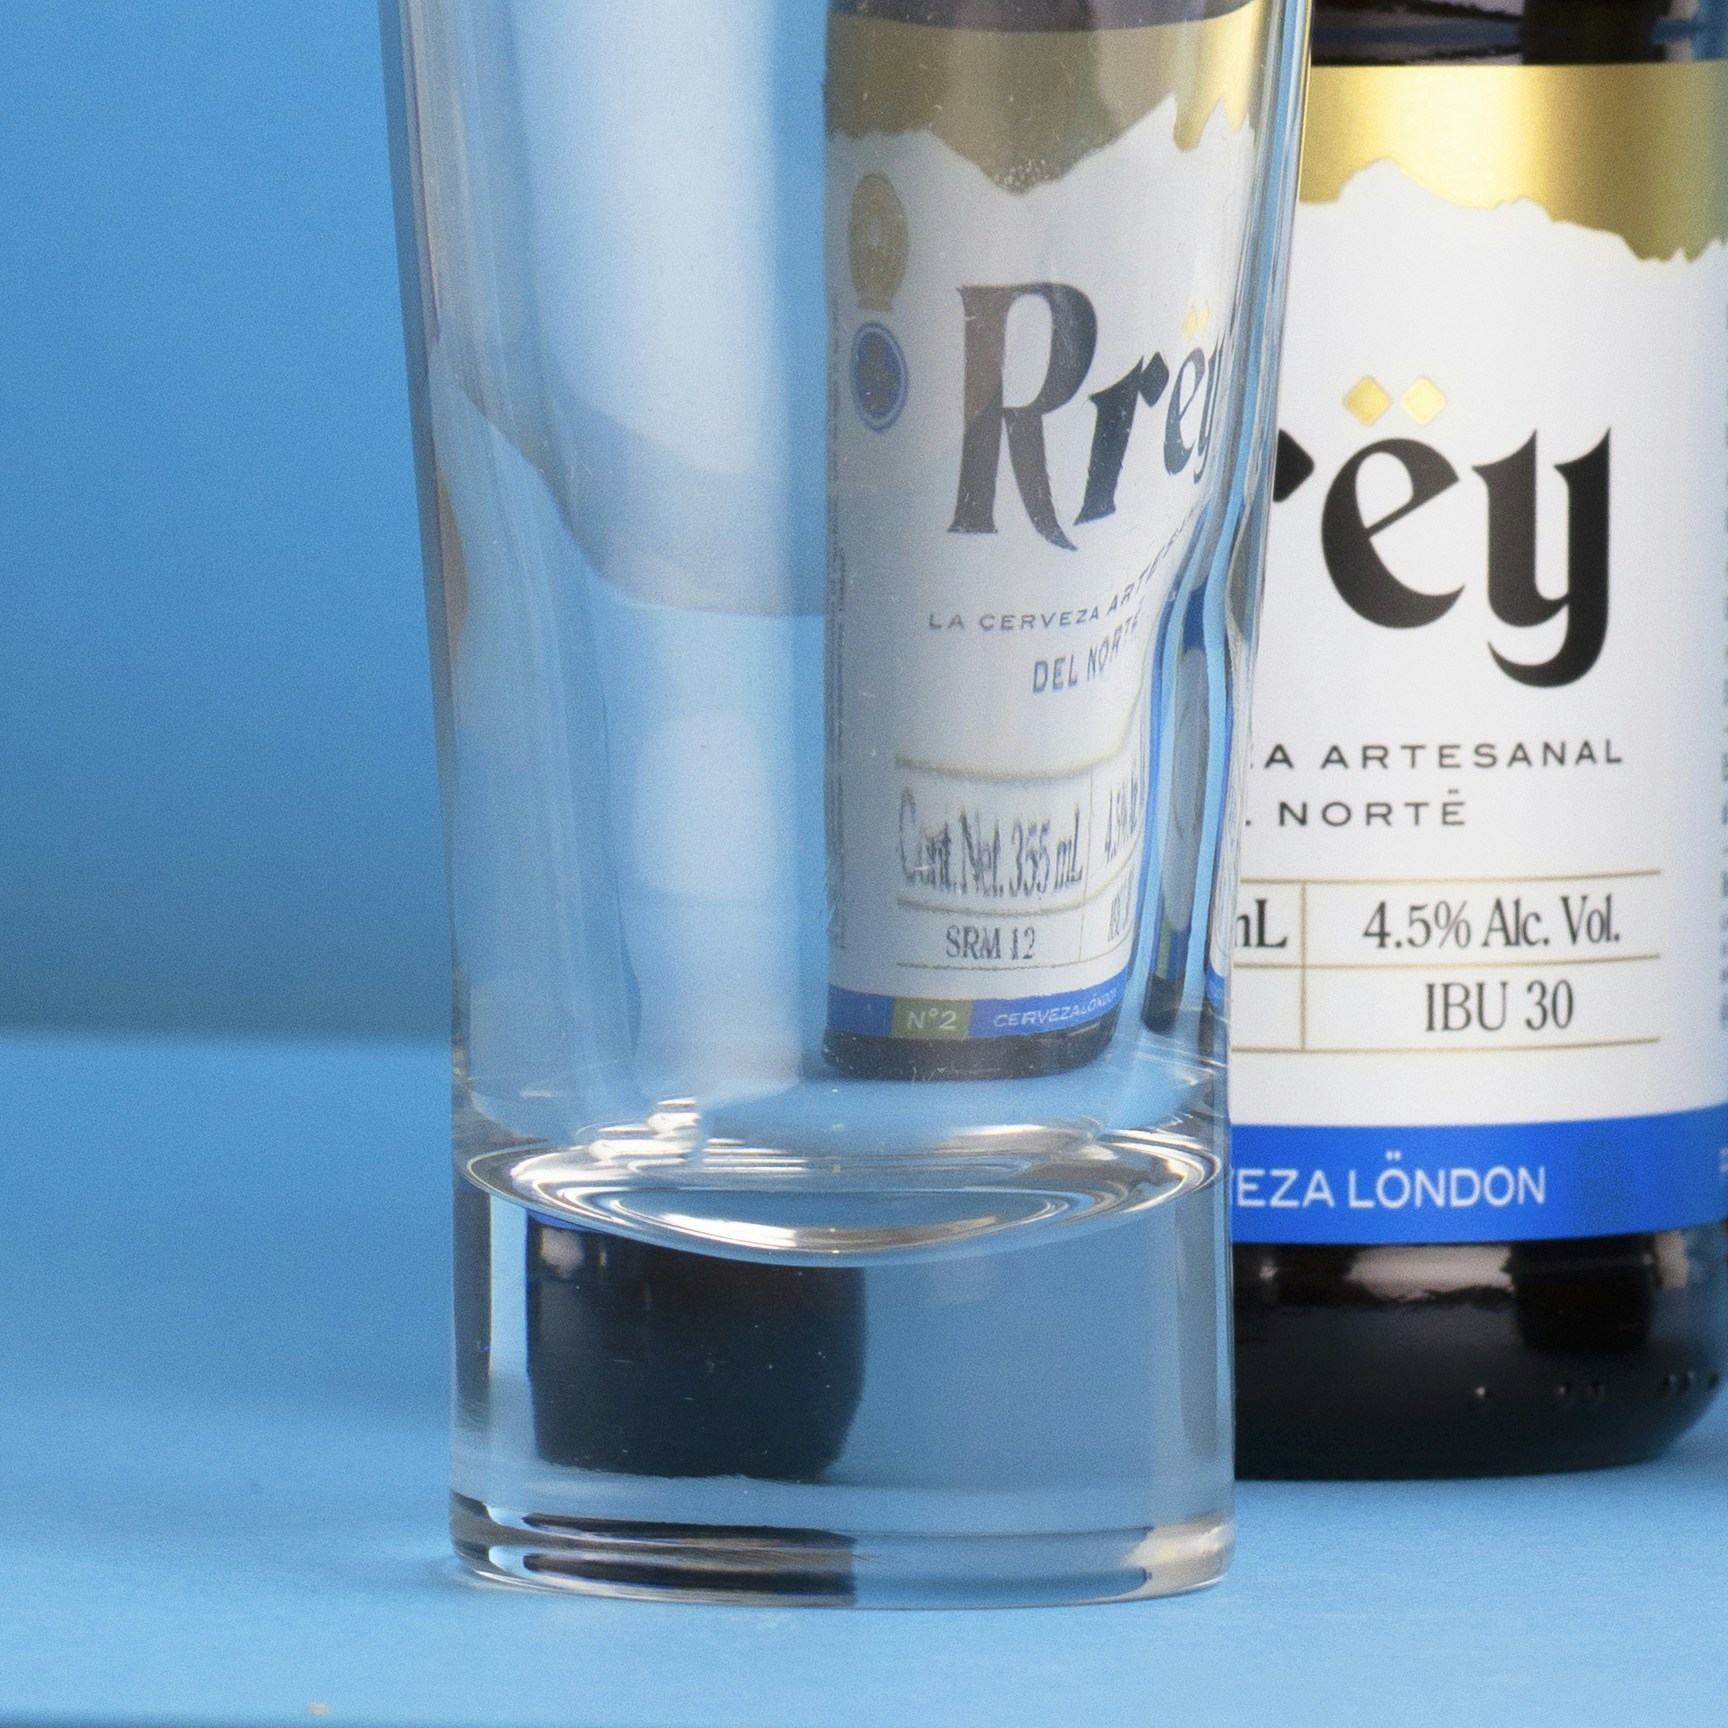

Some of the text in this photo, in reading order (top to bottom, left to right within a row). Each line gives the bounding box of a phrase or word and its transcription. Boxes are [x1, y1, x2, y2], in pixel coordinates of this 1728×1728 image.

[929, 612, 966, 631] LA
[979, 606, 1100, 632] CERVEZA
[1033, 654, 1079, 694] DEL
[1320, 739, 1623, 770] ARTESANAL
[1278, 787, 1467, 828] NORTË
[945, 924, 1002, 961] SRM
[1011, 926, 1037, 961] 12
[1361, 894, 1623, 951] 4.5% Alc. Vol.
[993, 1005, 1080, 1029] CERVEZA
[1423, 978, 1576, 1034] IBU 30
[1231, 1152, 1547, 1211] EZA LÖNDON
